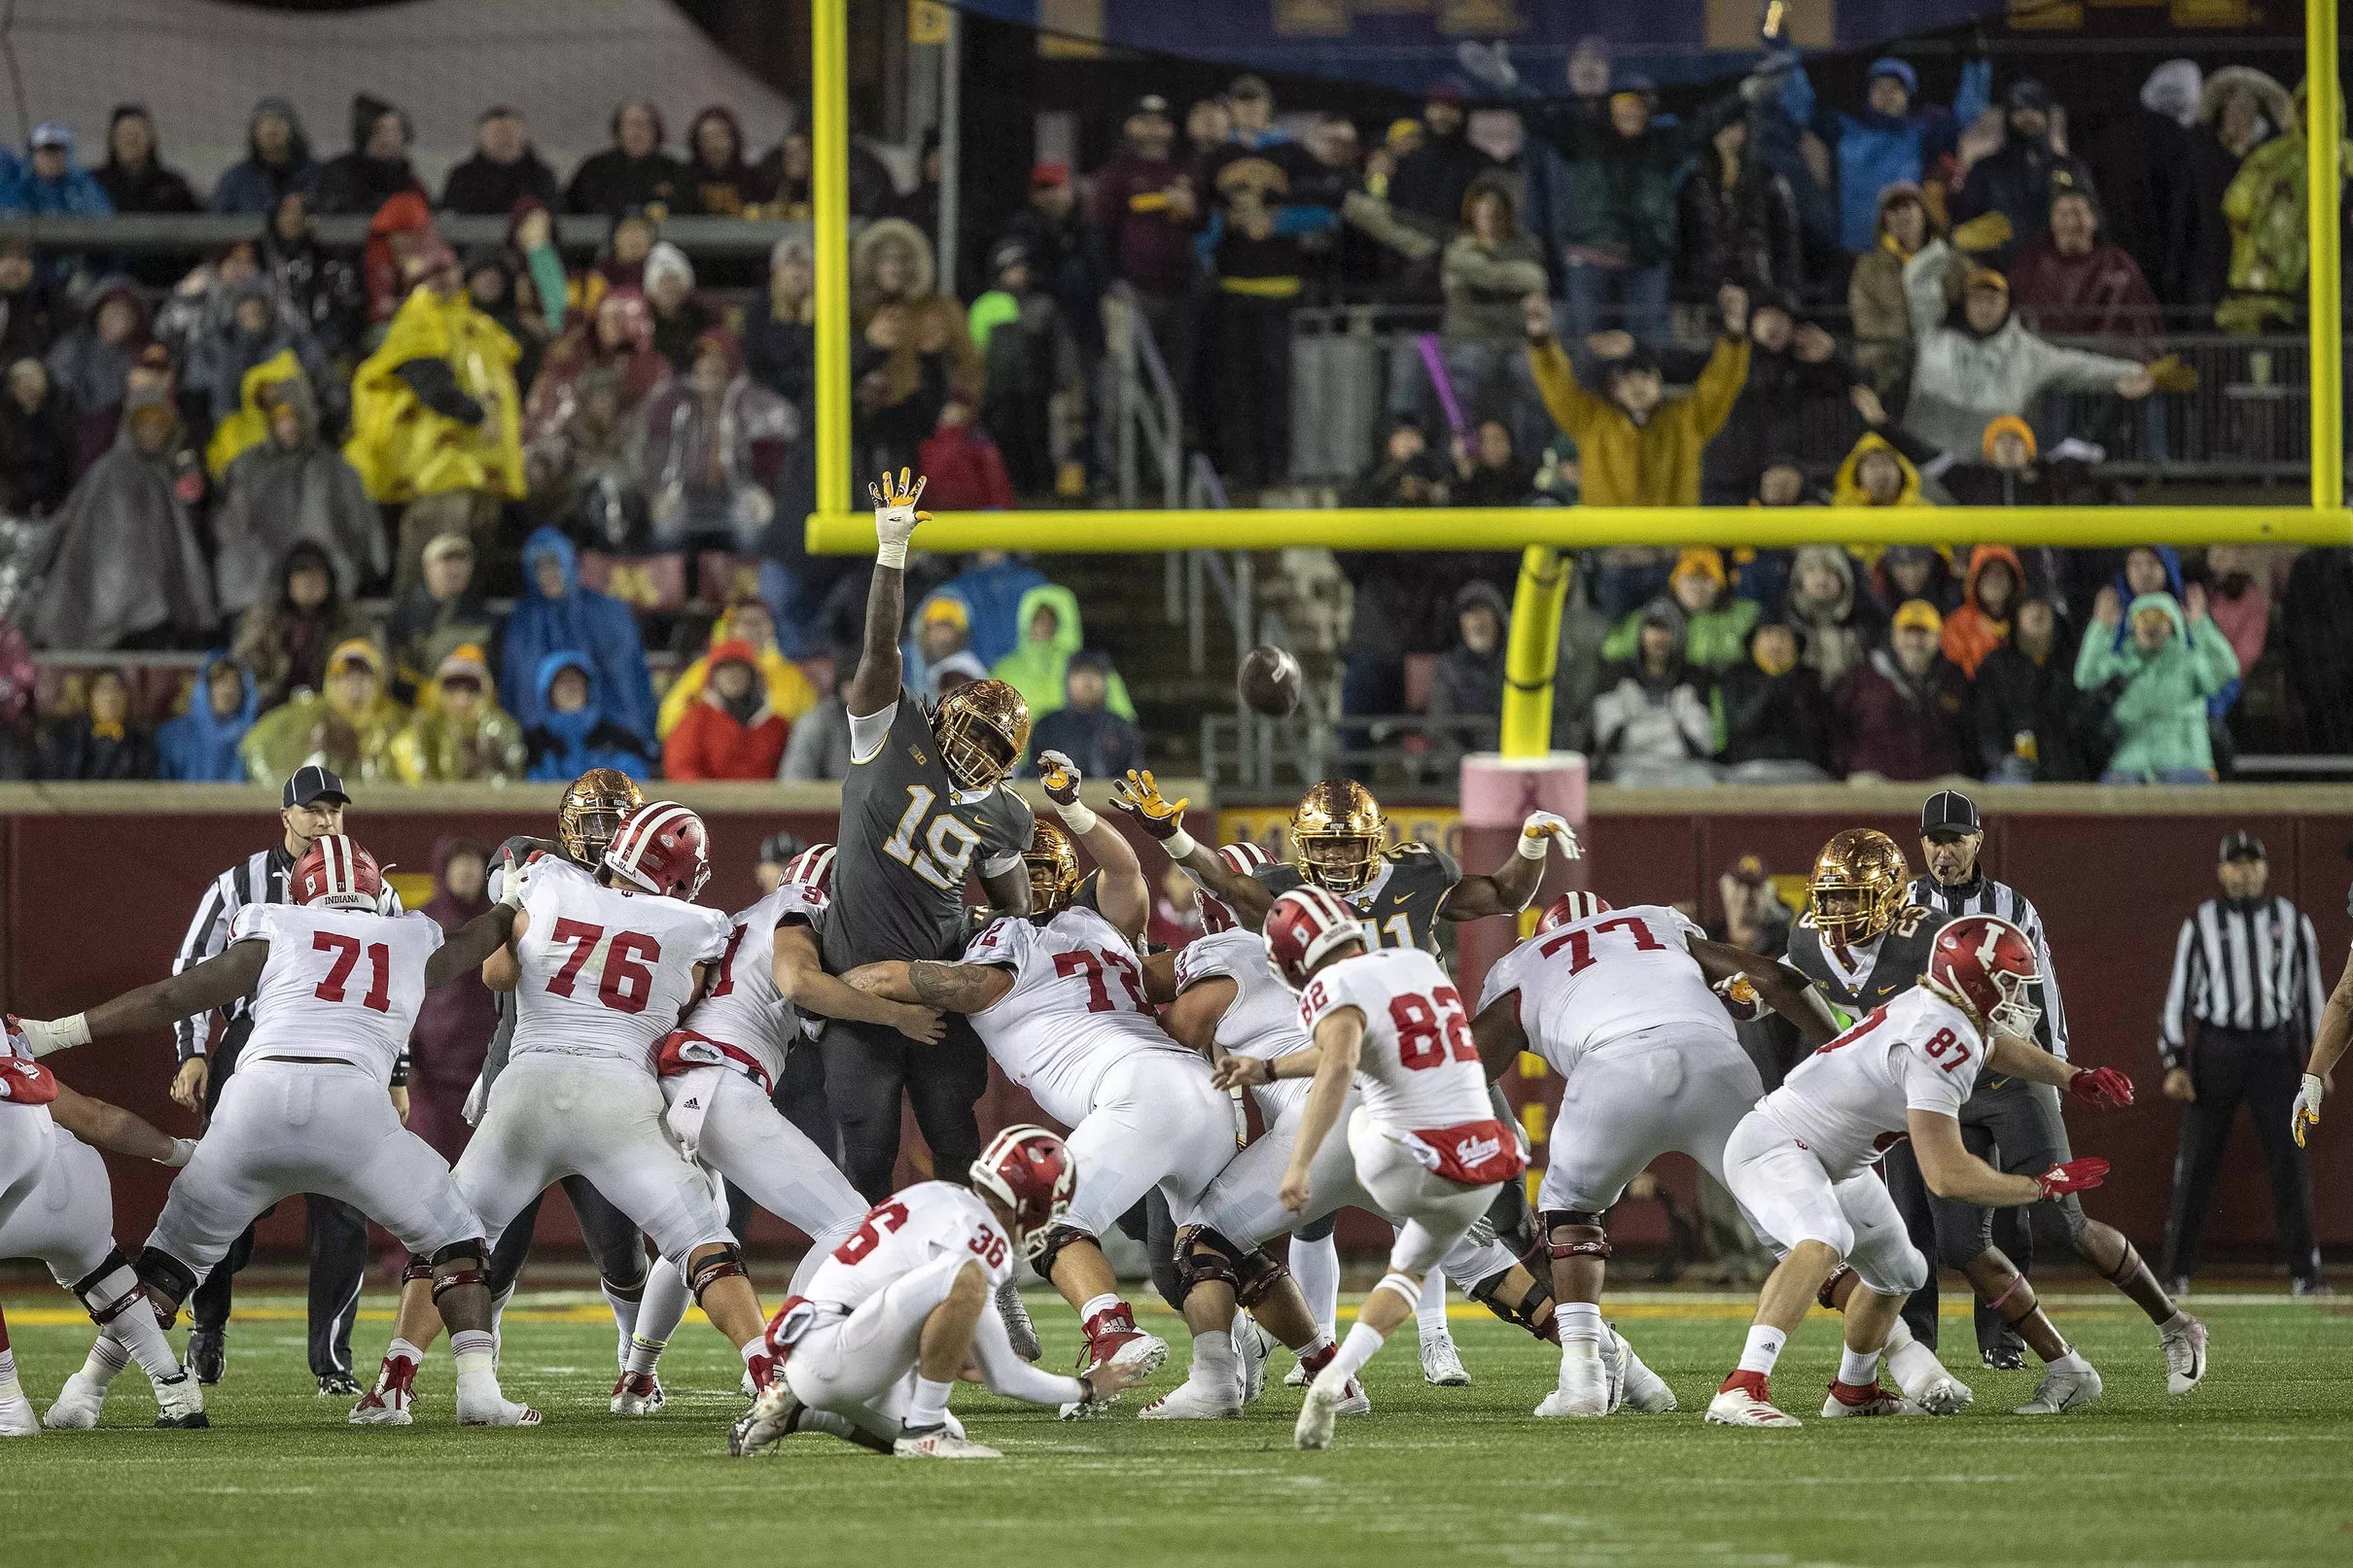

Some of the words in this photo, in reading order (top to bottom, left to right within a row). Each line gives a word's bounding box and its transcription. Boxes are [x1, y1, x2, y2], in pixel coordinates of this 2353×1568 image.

[883, 785, 982, 890] 19
[325, 894, 360, 905] INDIANA
[312, 929, 391, 1014] 71
[544, 917, 661, 1015] 76
[1539, 917, 1667, 977] 77
[1052, 948, 1155, 1016] 72
[1300, 981, 1329, 1026] 82
[1388, 986, 1482, 1071] 82
[1924, 1027, 1972, 1073] 87
[832, 1196, 909, 1266] 6
[968, 1223, 1008, 1269] 36
[1101, 1325, 1132, 1335] adidas
